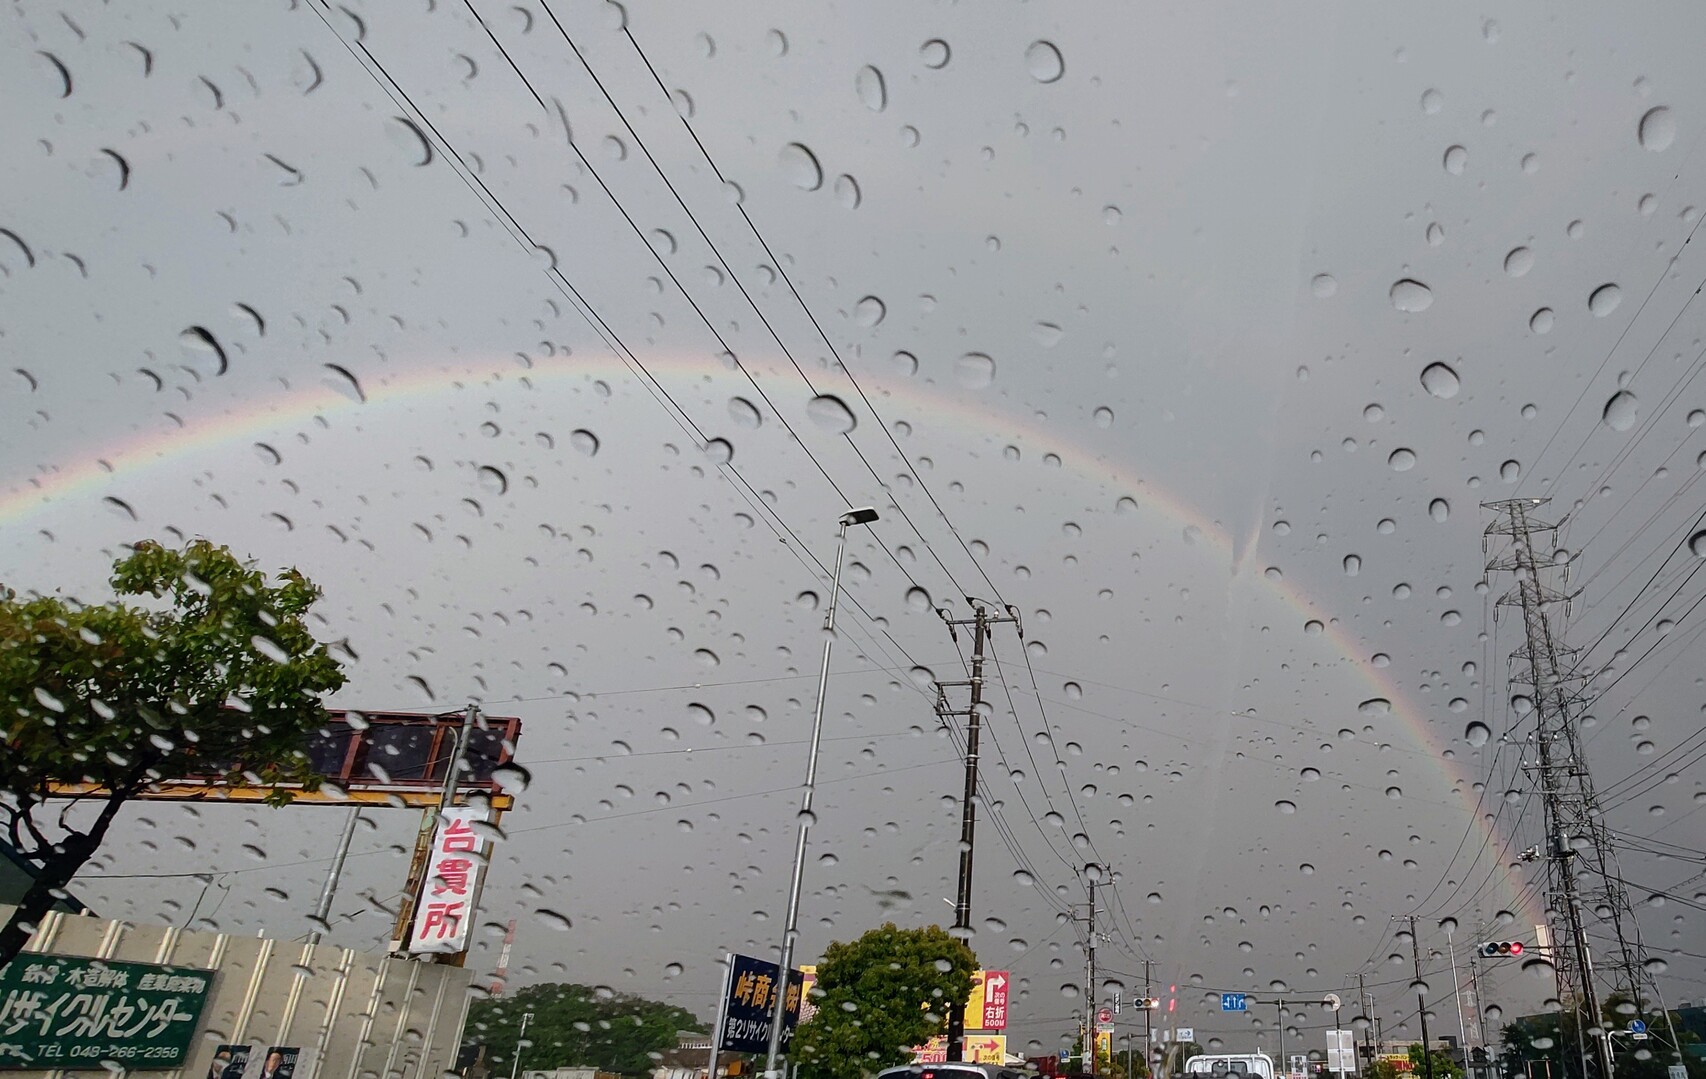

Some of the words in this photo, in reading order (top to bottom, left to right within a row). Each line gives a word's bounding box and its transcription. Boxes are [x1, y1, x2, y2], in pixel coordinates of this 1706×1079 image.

[419, 818, 476, 940] 台貫所
[985, 1006, 1005, 1019] 右折
[984, 1019, 1005, 1027] 500M
[37, 1044, 64, 1057] TEL
[70, 1045, 179, 1059] 048-266-2358
